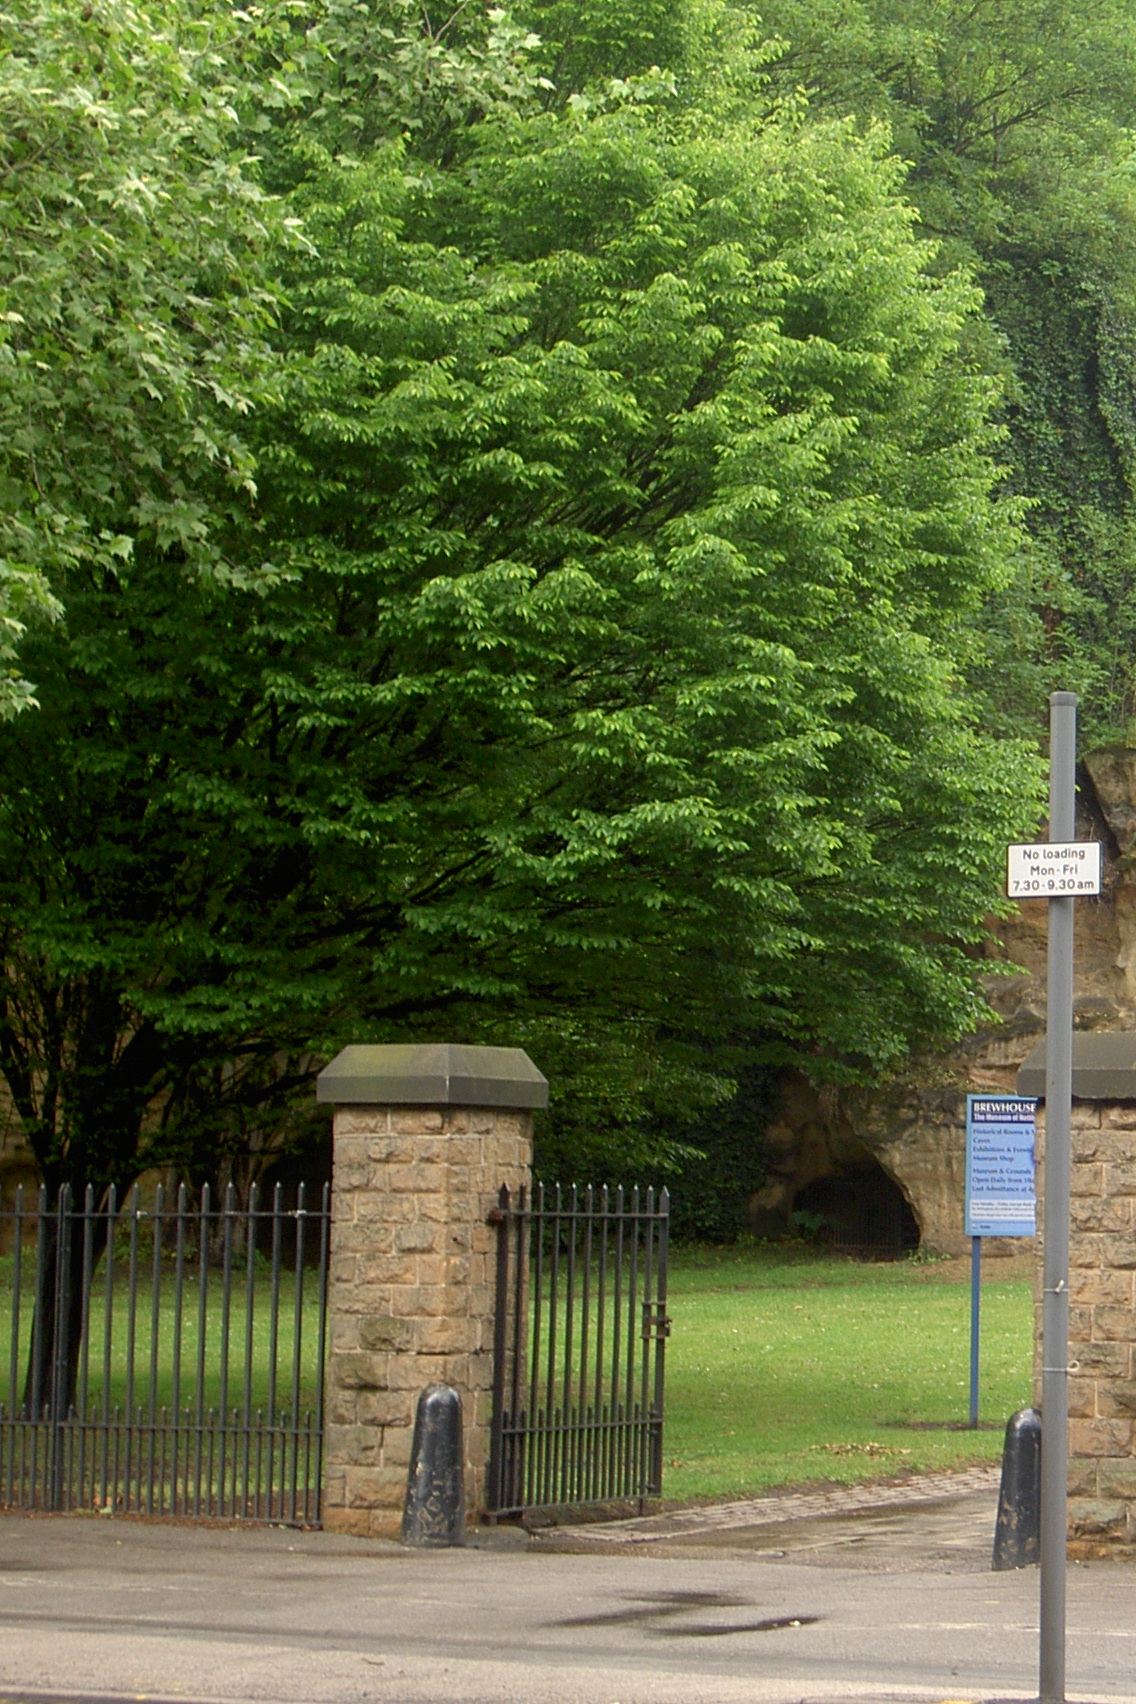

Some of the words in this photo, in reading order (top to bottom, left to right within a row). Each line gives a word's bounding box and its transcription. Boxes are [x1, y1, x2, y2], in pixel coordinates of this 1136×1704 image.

[1022, 849, 1039, 860] No
[1043, 848, 1085, 860] loading
[1030, 865, 1055, 876] Mon
[1062, 864, 1078, 875] Fri
[1013, 880, 1040, 892] 7.30
[973, 1102, 1036, 1112] BREWHOUSE
